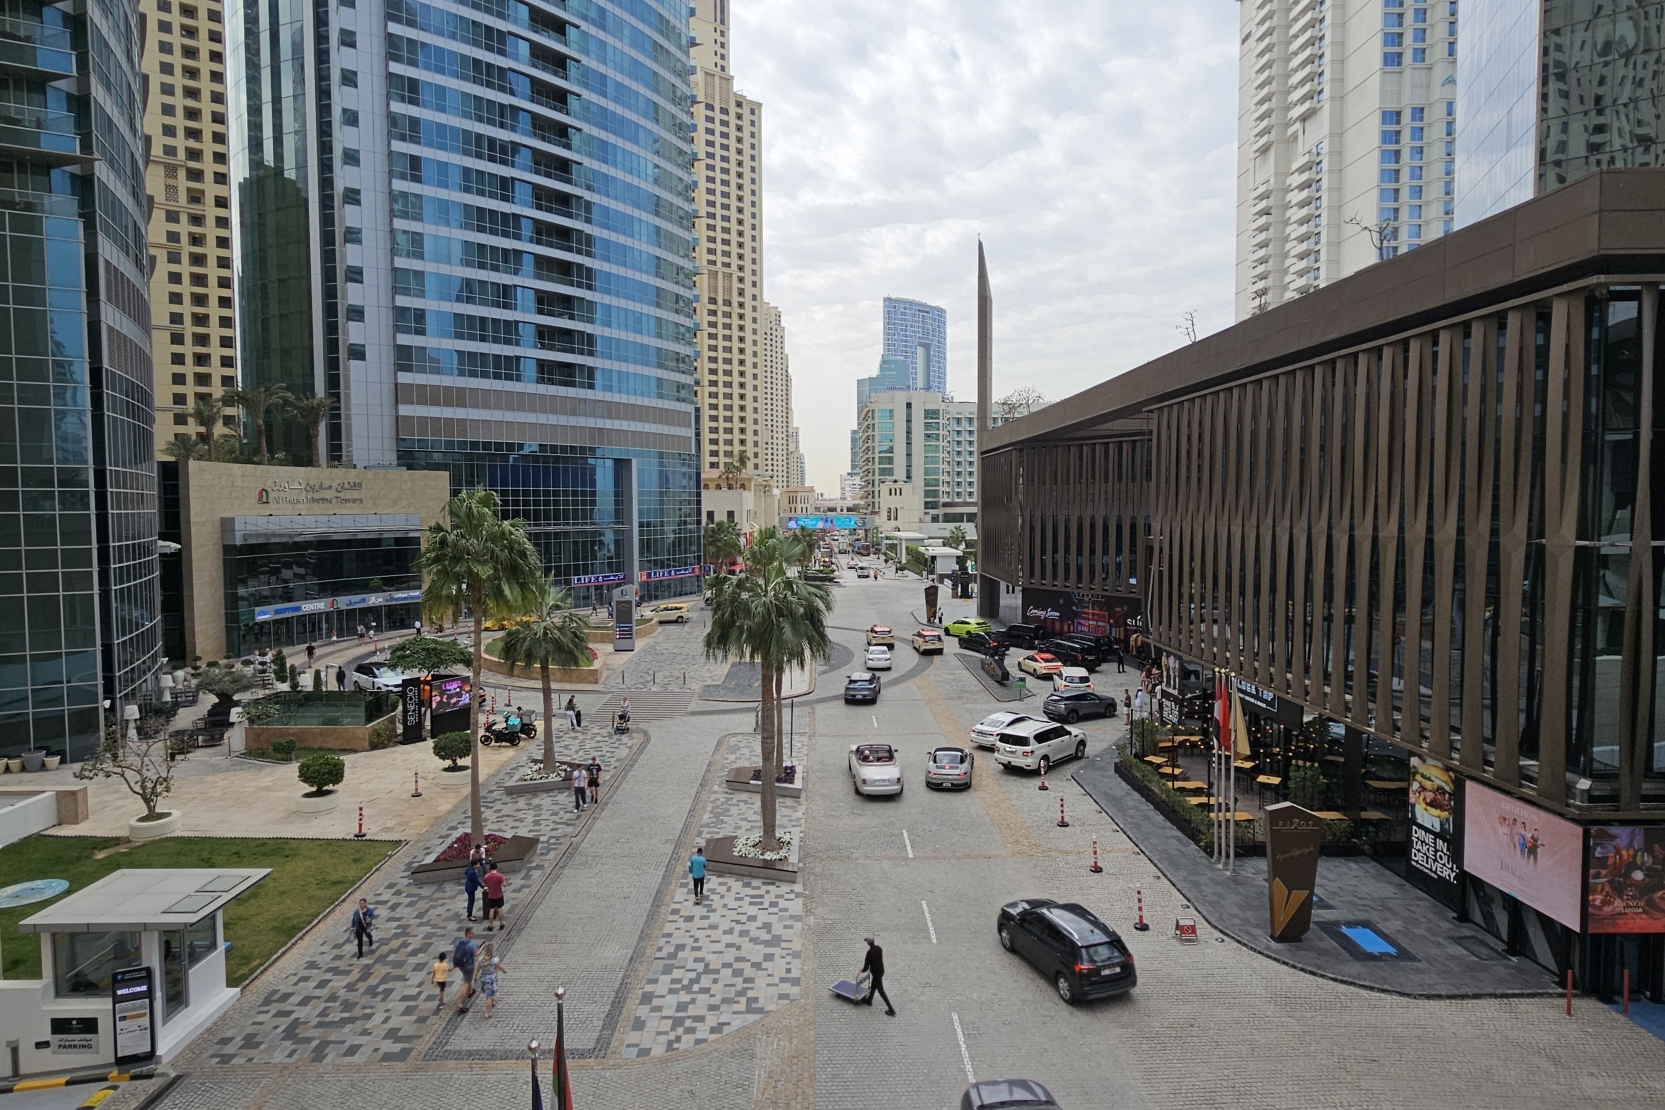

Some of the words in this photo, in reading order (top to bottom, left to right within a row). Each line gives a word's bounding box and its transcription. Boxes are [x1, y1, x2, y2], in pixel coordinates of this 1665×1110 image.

[334, 496, 363, 504] Towers
[574, 575, 598, 584] LIFE
[651, 568, 670, 578] LIFE
[302, 602, 325, 612] CENTRE
[1026, 605, 1047, 620] Coming
[1045, 607, 1061, 620] Soon
[1234, 678, 1257, 695] LACK
[406, 686, 416, 726] SENECIO
[1501, 802, 1540, 821] ammos
[1278, 818, 1314, 829] RIXOS
[1412, 825, 1435, 847] DINE
[1436, 838, 1450, 855] IN.
[1411, 836, 1435, 860] TAKE
[1411, 848, 1457, 884] DELIVERY.
[116, 984, 148, 995] WELCOME
